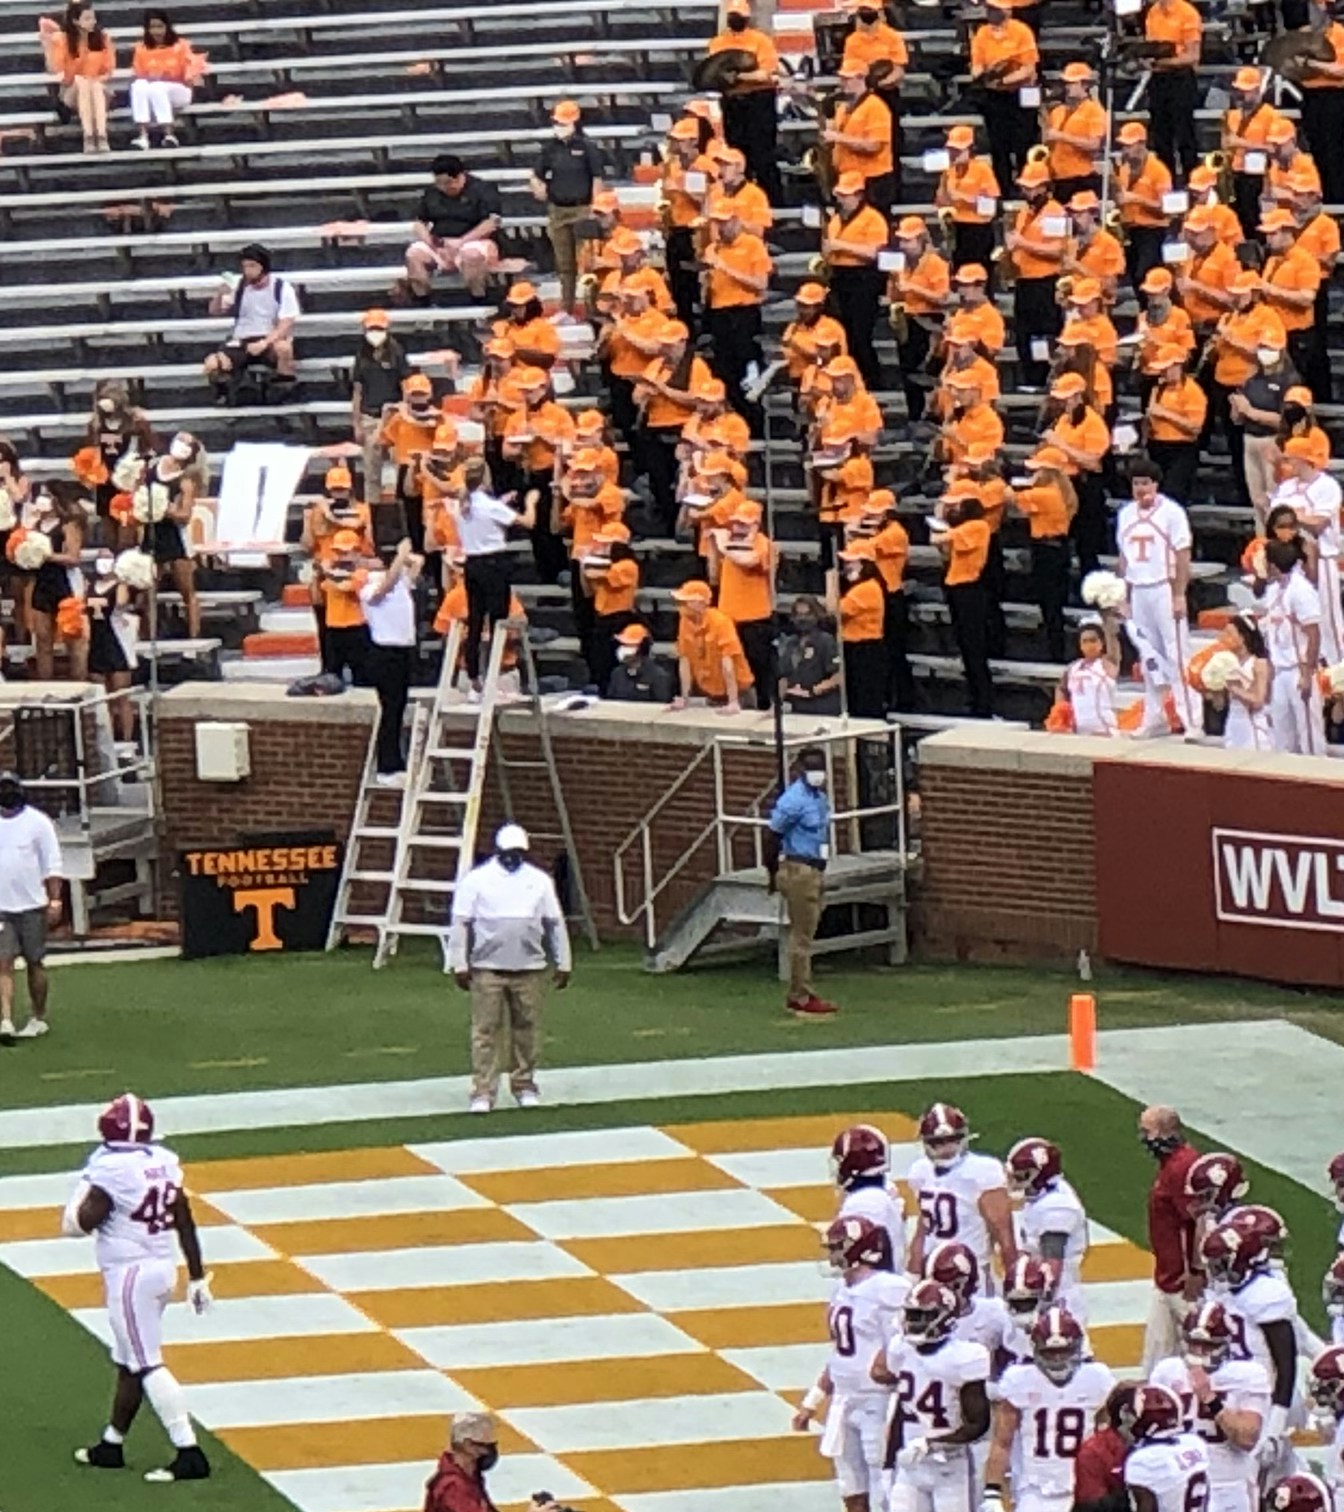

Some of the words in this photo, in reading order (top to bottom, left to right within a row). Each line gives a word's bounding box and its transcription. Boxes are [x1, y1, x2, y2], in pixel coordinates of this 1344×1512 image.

[1131, 535, 1154, 562] T
[186, 845, 338, 876] TENNESSEE
[217, 872, 309, 888] FOOTBALL
[233, 887, 295, 950] T
[919, 1191, 958, 1238] 50
[893, 1371, 950, 1428] 24
[1033, 1407, 1084, 1458] 18
